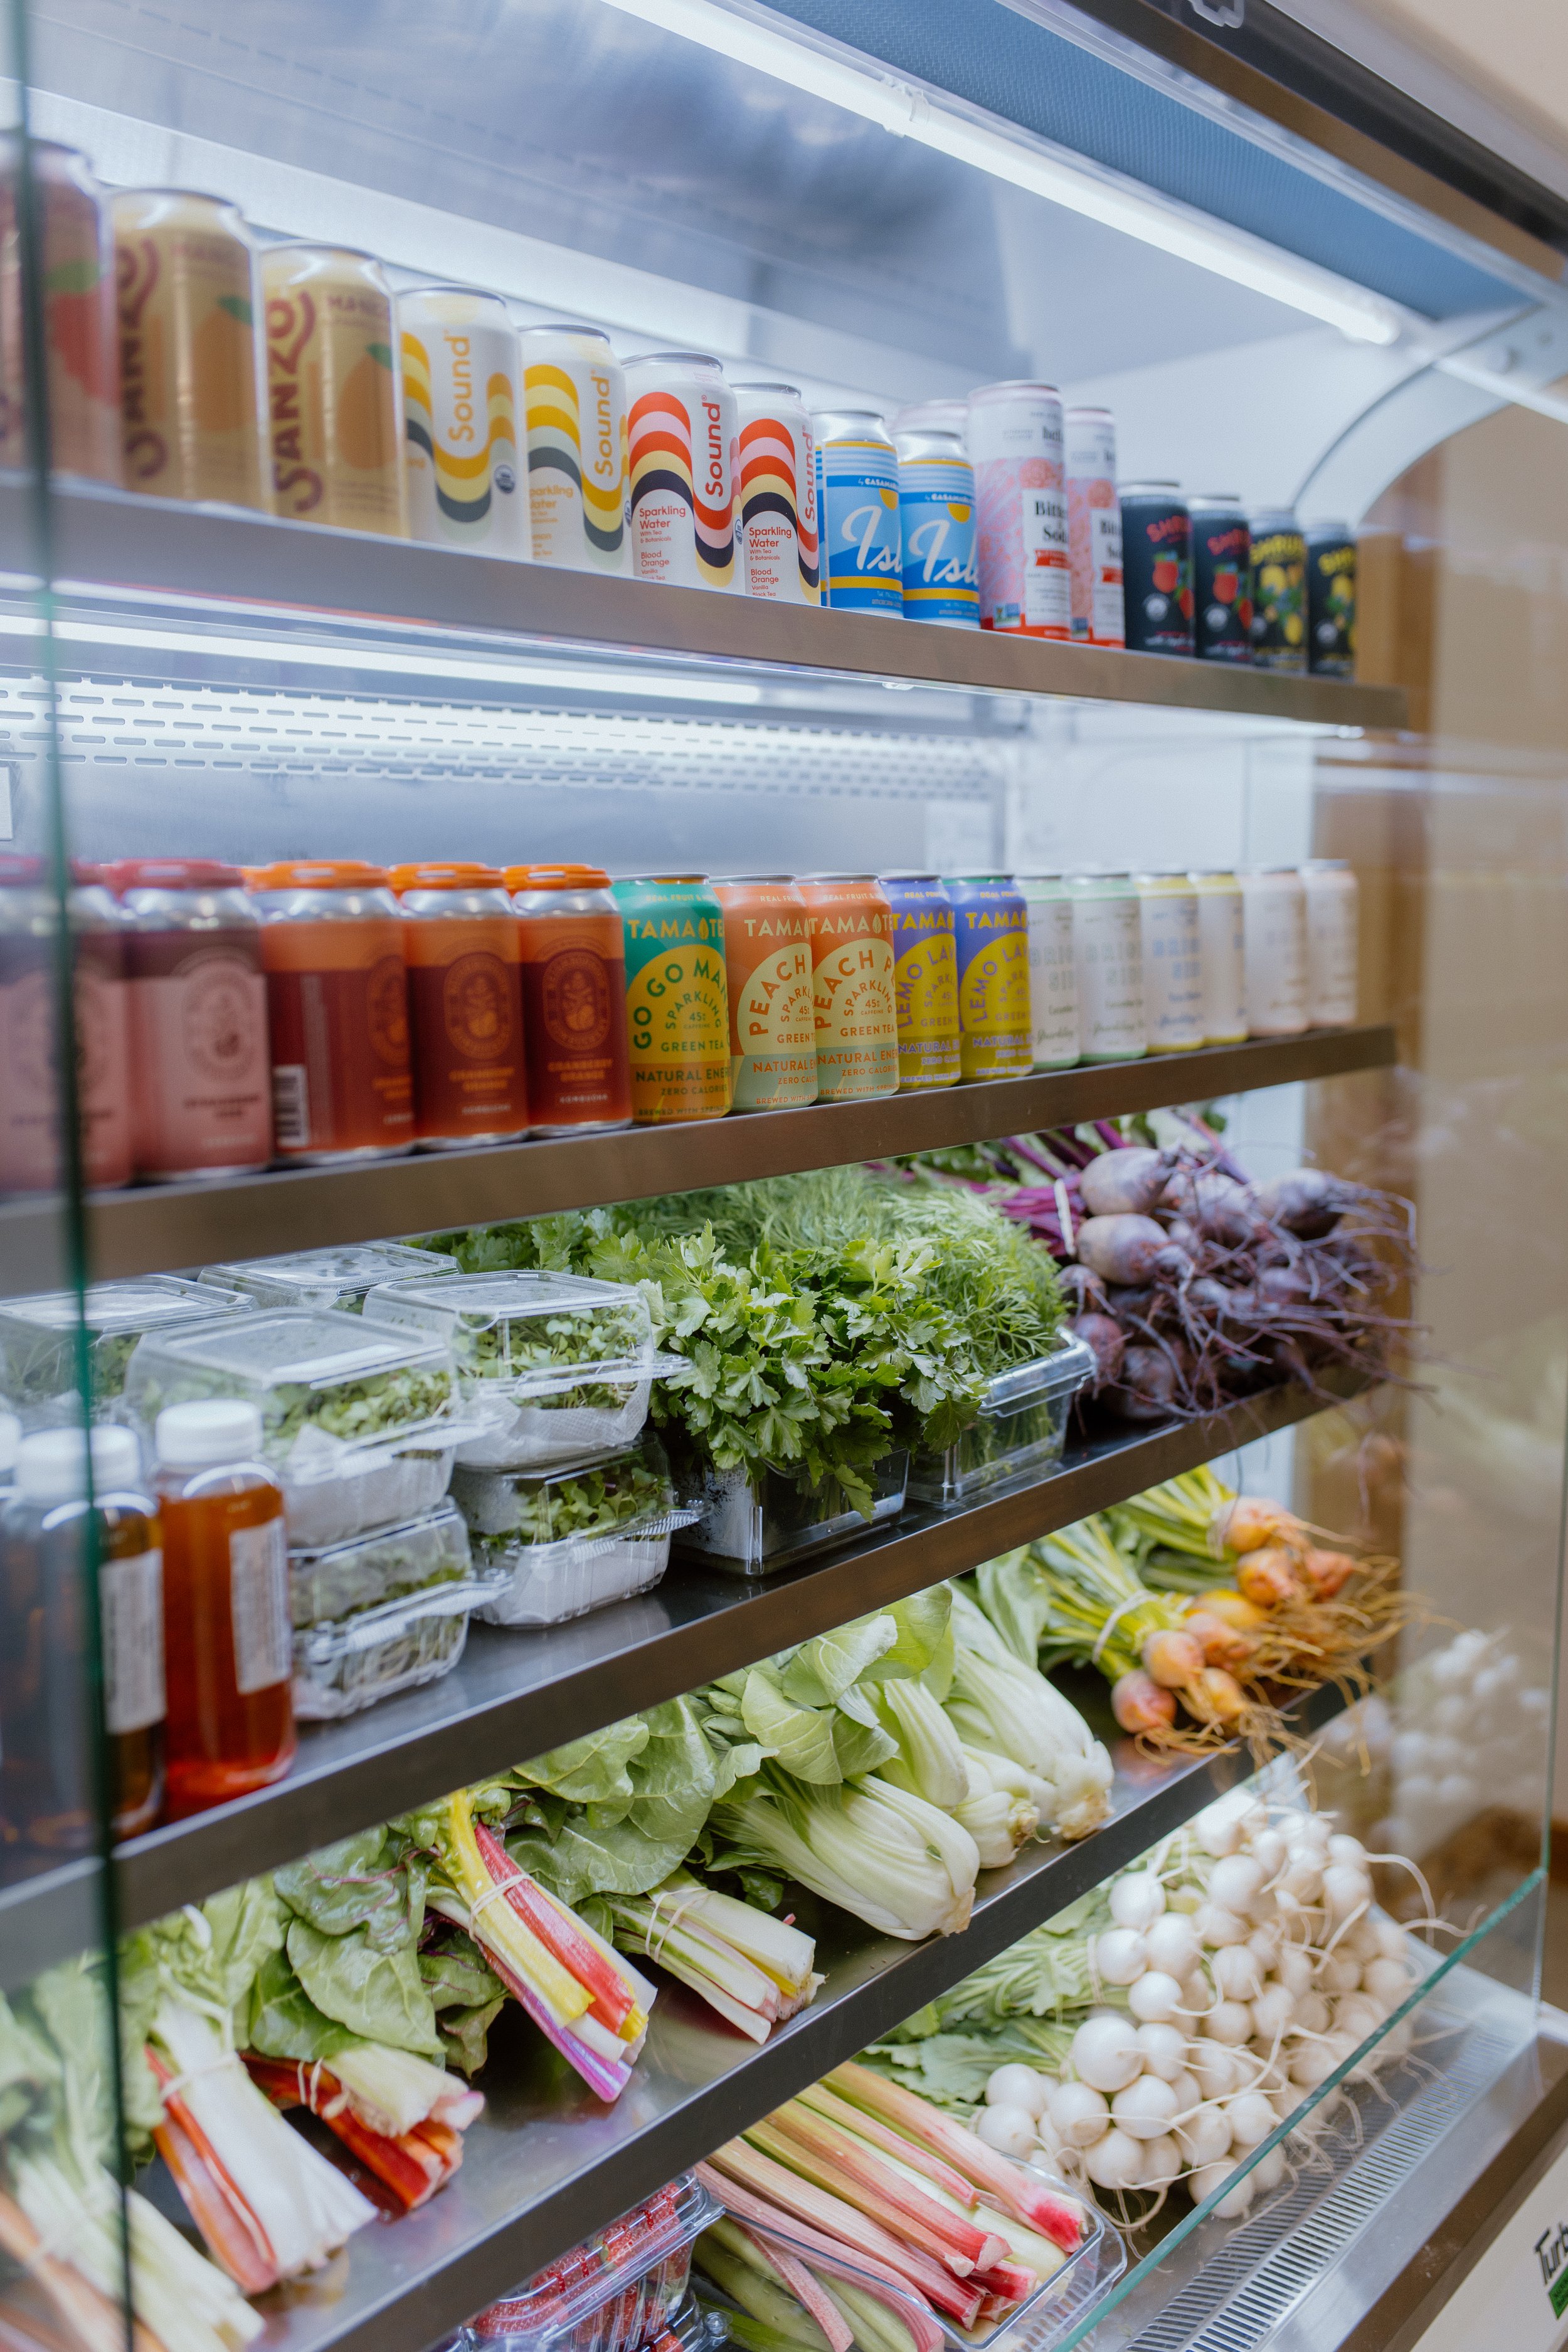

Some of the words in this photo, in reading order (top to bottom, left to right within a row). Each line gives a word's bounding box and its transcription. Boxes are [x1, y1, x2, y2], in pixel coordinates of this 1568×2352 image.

[445, 335, 474, 443] Sound
[591, 375, 614, 477] Sound
[702, 402, 724, 497] Sound
[802, 430, 815, 522] Sound
[639, 506, 686, 518] Sparkling
[640, 520, 671, 530] Water
[749, 527, 792, 539] Sparkling
[749, 539, 779, 548] Water
[641, 550, 662, 559] Blood
[641, 559, 669, 568] Orange
[751, 576, 779, 585] Orange
[810, 916, 870, 935] TAMA
[891, 912, 946, 930] TAMA
[965, 911, 1021, 930] TAMA
[628, 918, 696, 939] TAMA
[744, 918, 803, 937] TAMA
[749, 954, 806, 1036] PEACH
[815, 950, 874, 1030] PEACH
[895, 963, 923, 1029] LEMO
[970, 961, 997, 1023] LEMO
[844, 980, 892, 1017] SPARKLING
[633, 1005, 652, 1049] GO
[646, 963, 683, 997] GO
[665, 990, 721, 1030] SPARKLING
[921, 1017, 952, 1027] GREEN
[840, 1026, 880, 1037] GREEN
[882, 1024, 895, 1034] TEA
[776, 1033, 810, 1044] GREEN
[973, 1035, 1024, 1048] NATURAL
[660, 1041, 706, 1052] GREEN
[709, 1040, 724, 1050] TEA
[898, 1041, 951, 1054] NATURAL
[818, 1051, 879, 1065] NATURAL
[753, 1060, 808, 1073] NATURAL
[842, 1068, 866, 1076] ZERO
[635, 1069, 702, 1083] NATURAL
[778, 1076, 799, 1085] ZERO
[661, 1087, 689, 1096] ZERO
[820, 1088, 854, 1096] BREWED
[756, 1097, 788, 1105] BREWED
